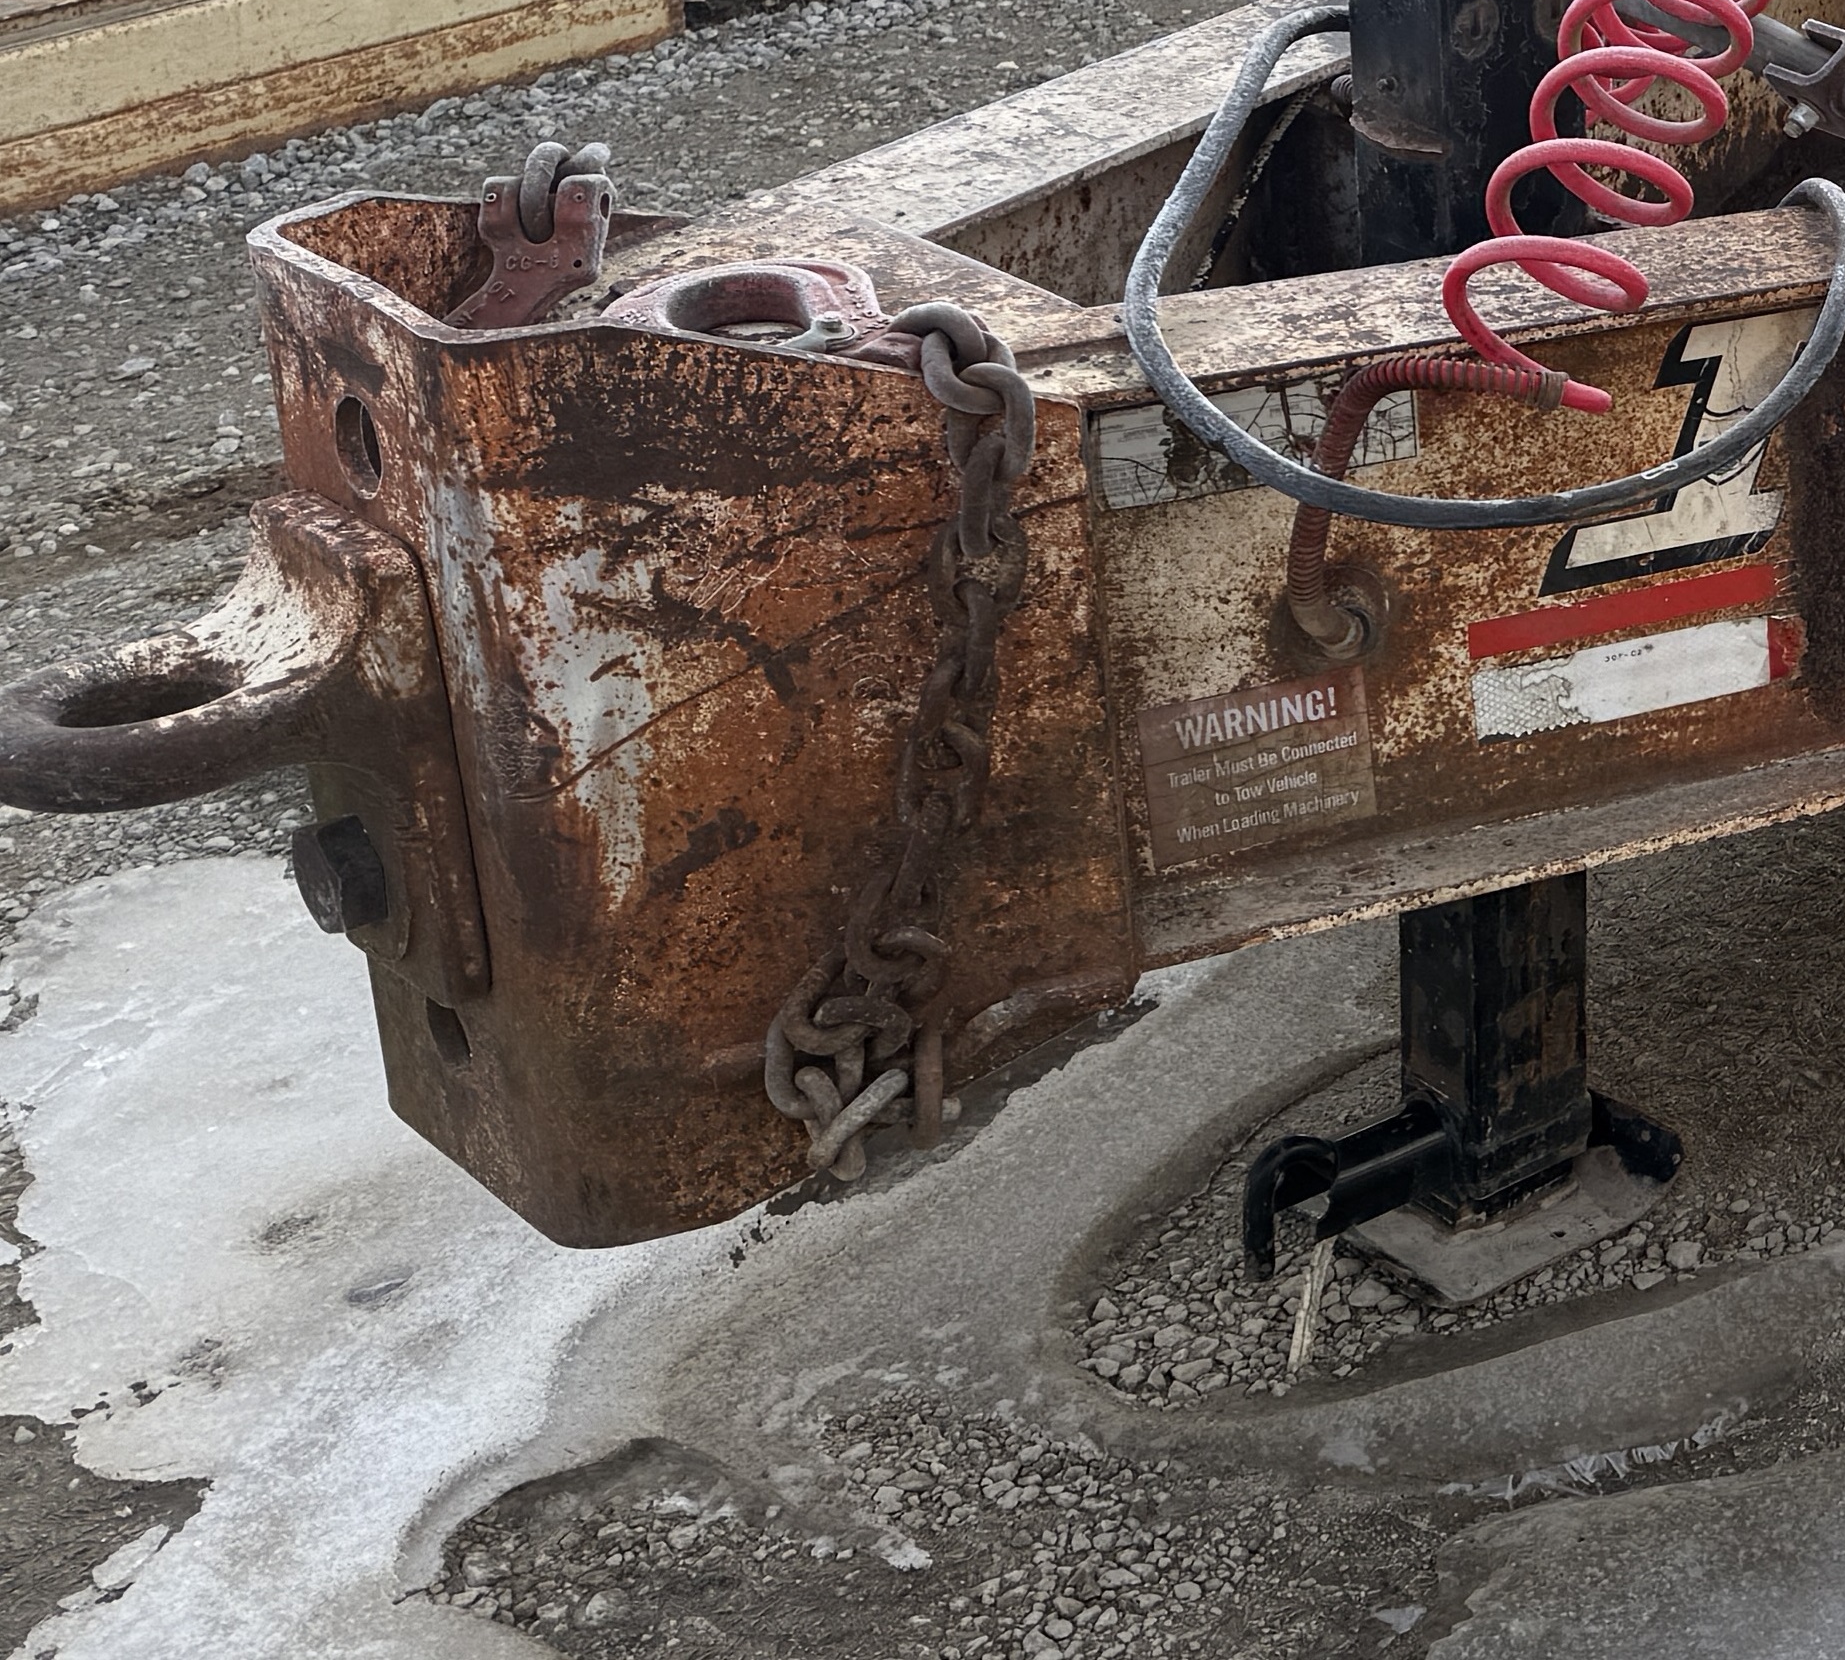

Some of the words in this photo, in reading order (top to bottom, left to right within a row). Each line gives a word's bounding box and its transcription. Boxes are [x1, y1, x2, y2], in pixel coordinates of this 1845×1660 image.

[1175, 686, 1337, 750] WARNING!
[1167, 766, 1211, 789] Trailer
[1215, 755, 1255, 778] Must
[1257, 751, 1279, 769] Be
[1281, 731, 1358, 761] Connected
[1215, 791, 1230, 807] to
[1234, 784, 1264, 803] Tow
[1266, 770, 1318, 795] Vehicle
[1177, 822, 1221, 844] When
[1222, 807, 1281, 834] Loading
